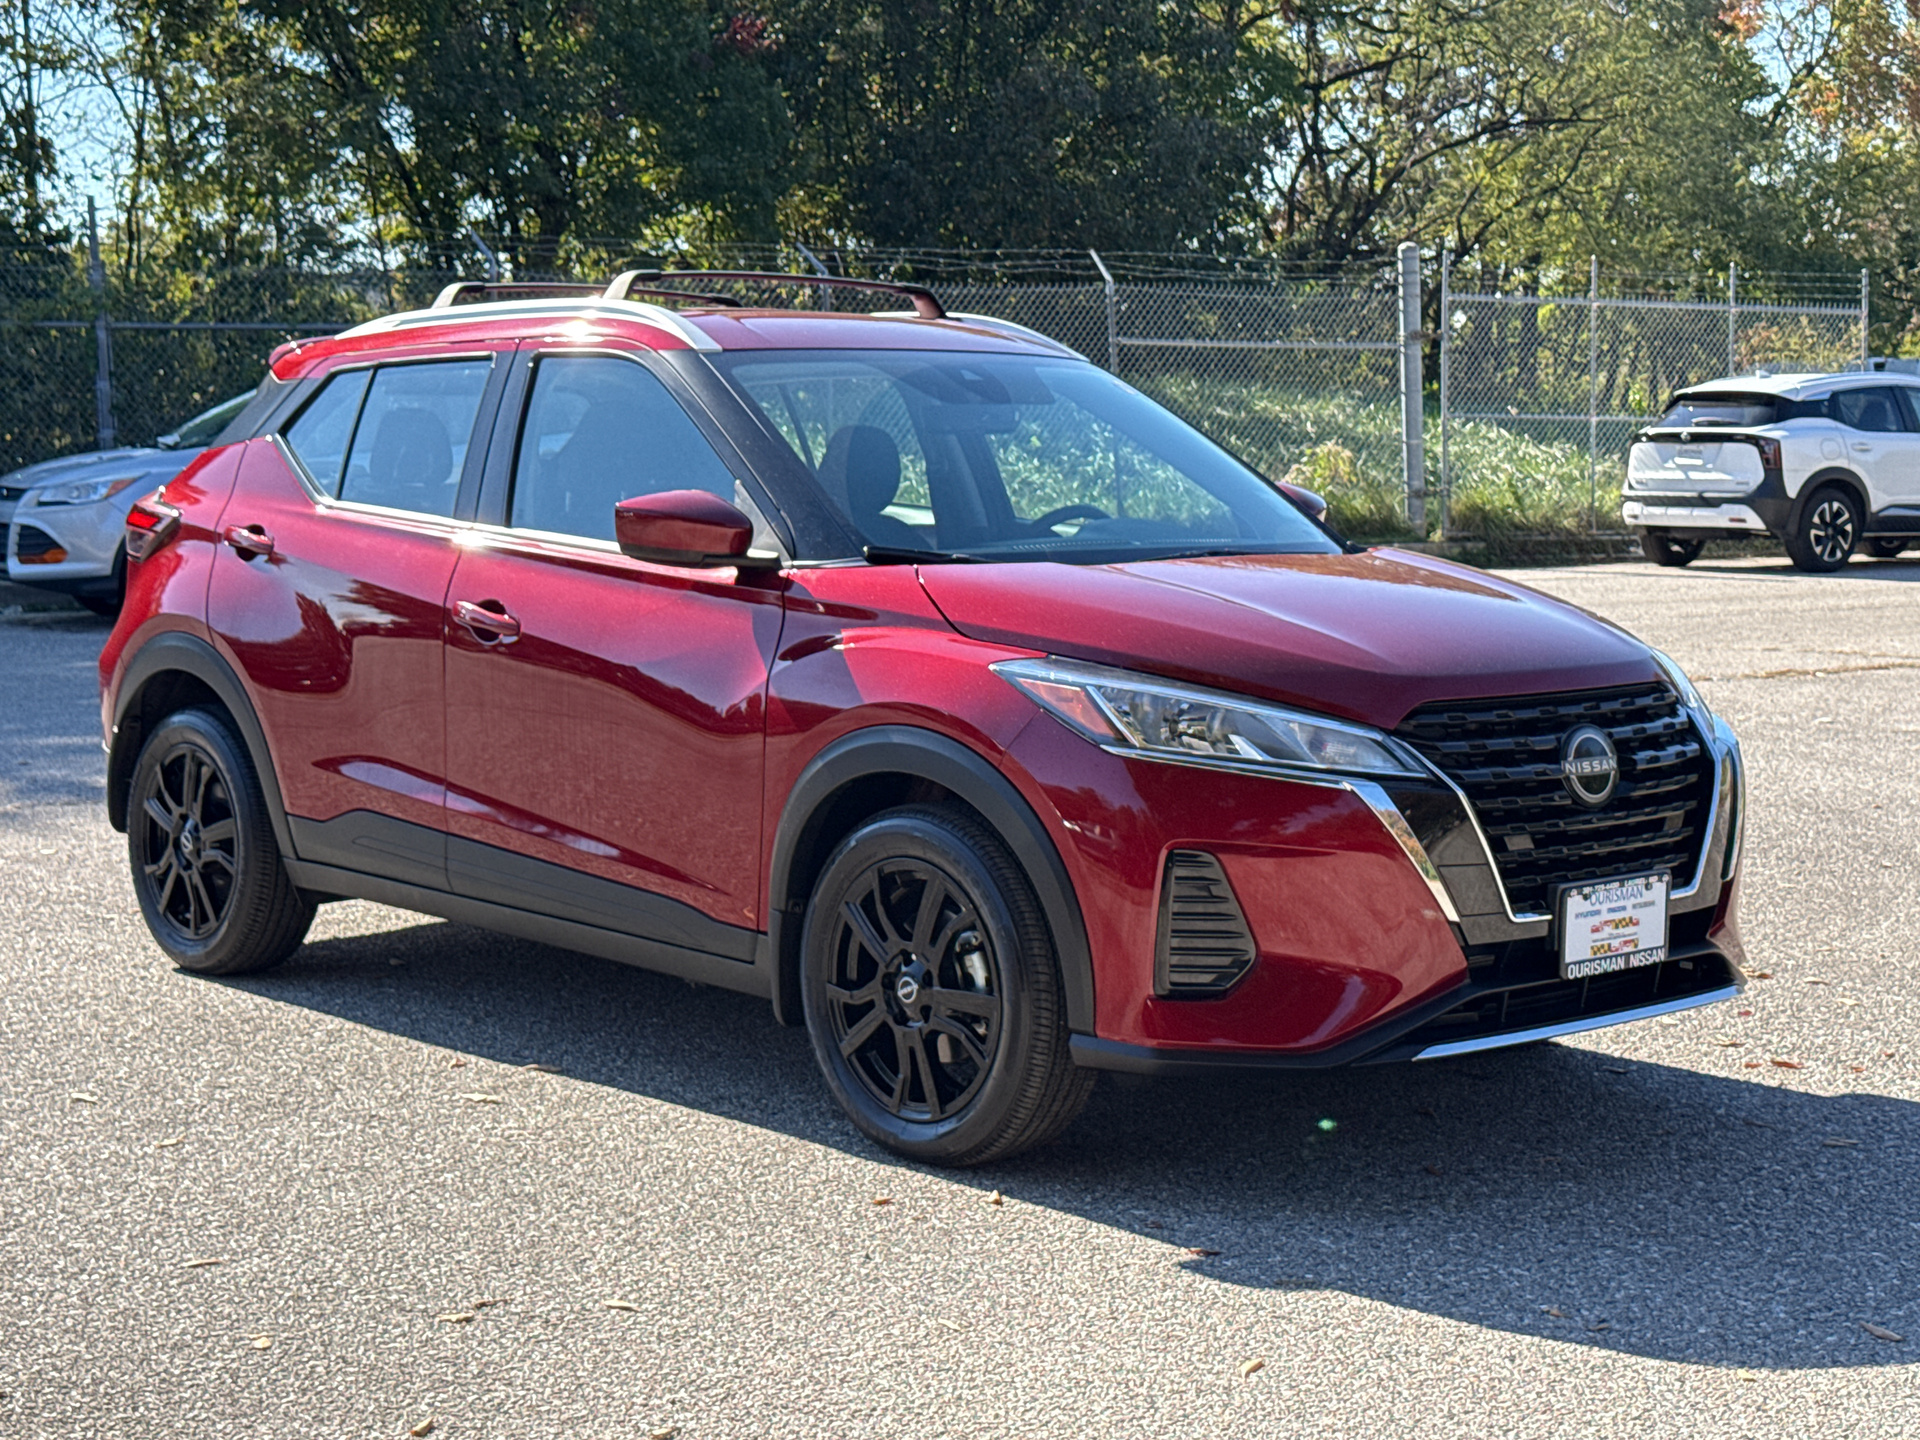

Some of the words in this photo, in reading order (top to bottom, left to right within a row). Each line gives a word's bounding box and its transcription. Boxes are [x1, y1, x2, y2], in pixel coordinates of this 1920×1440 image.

[1565, 758, 1617, 774] NISSAN
[1589, 885, 1643, 906] OURISMAN
[1567, 955, 1625, 980] OURISMAN
[1629, 948, 1665, 968] NISSAN
